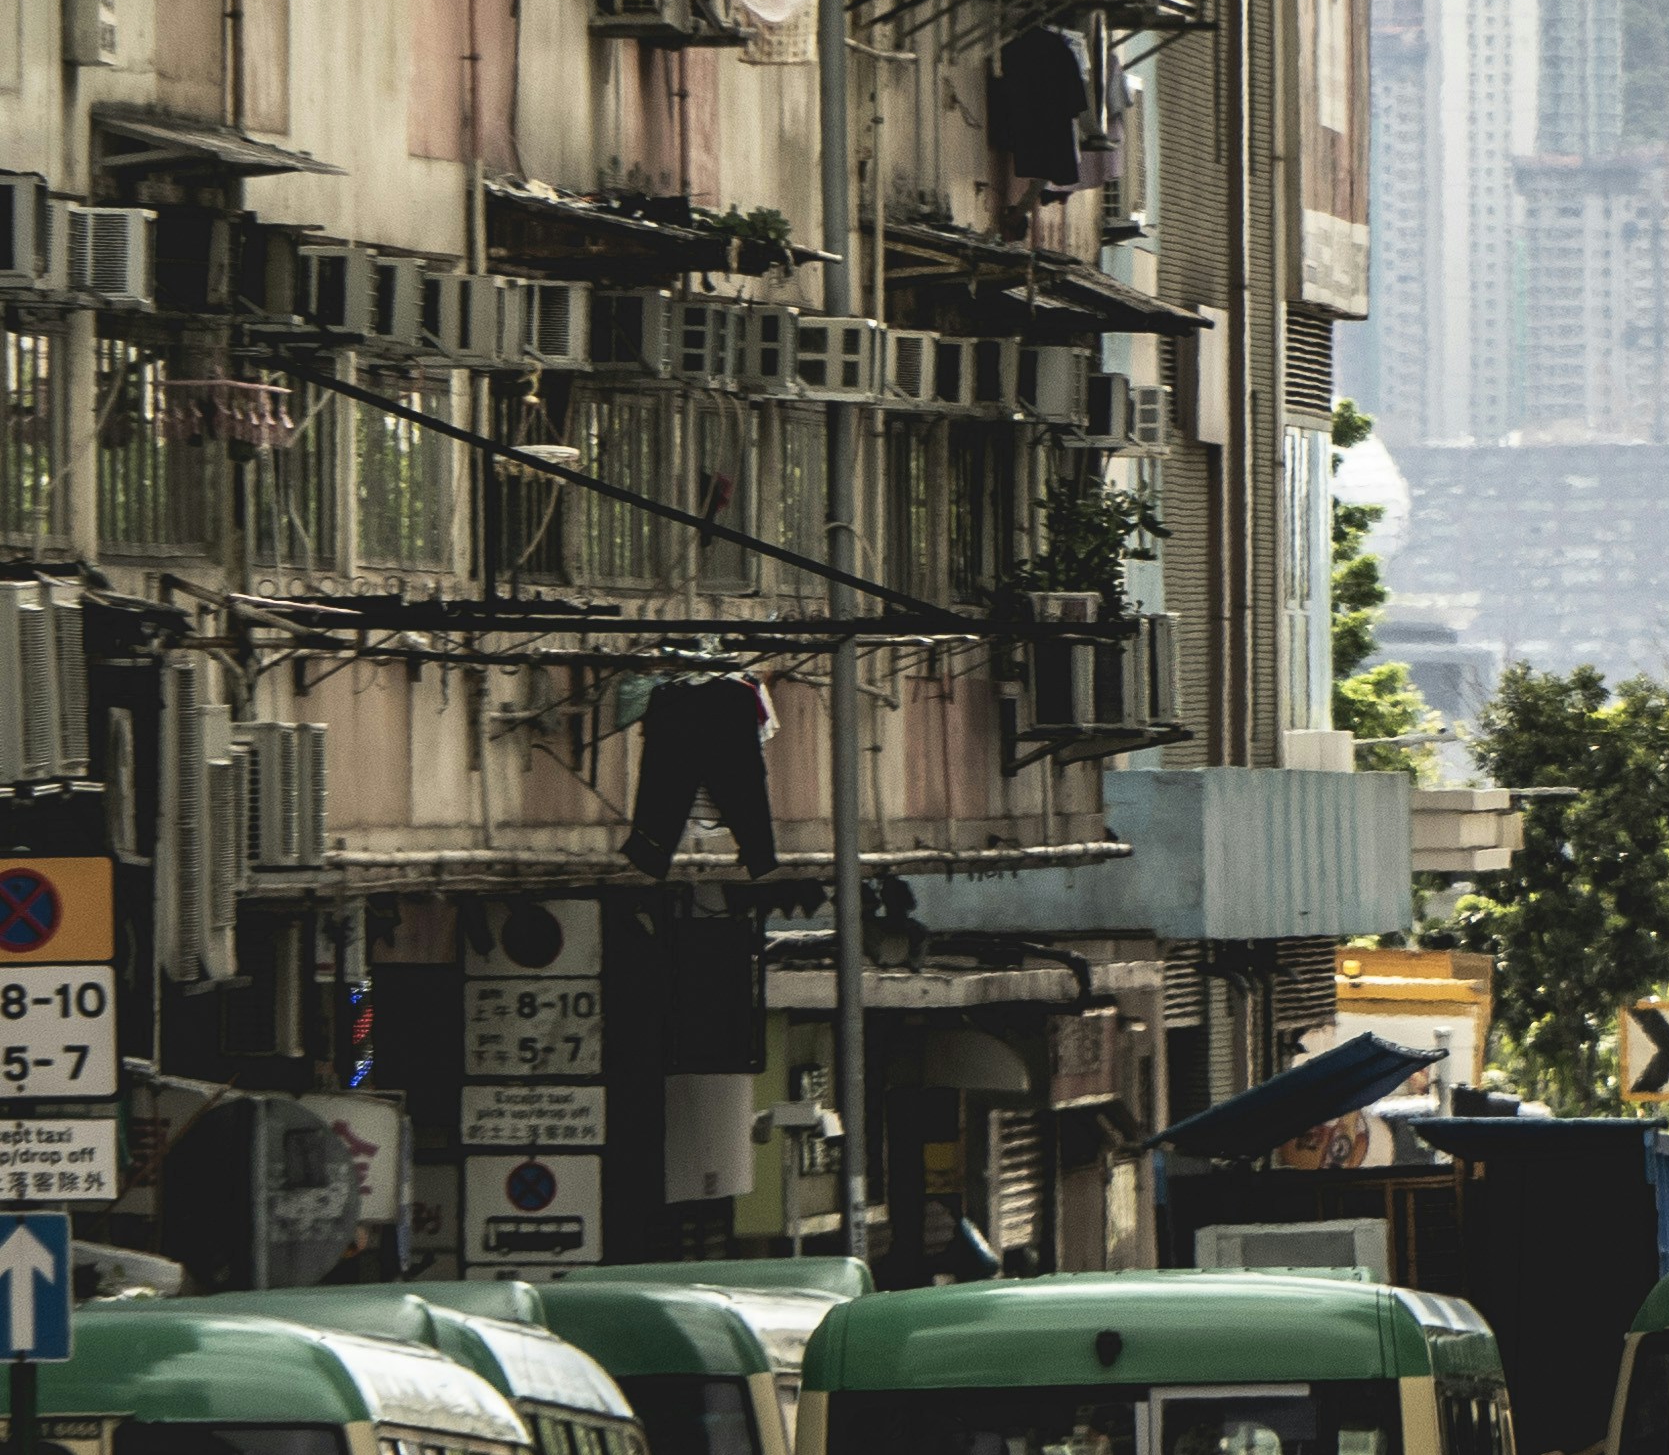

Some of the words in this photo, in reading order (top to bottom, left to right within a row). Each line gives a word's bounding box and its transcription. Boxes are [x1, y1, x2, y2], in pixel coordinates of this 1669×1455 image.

[1, 982, 106, 1020] 8-10
[517, 992, 595, 1019] 8-10
[36, 1127, 73, 1144] taxi
[67, 1147, 97, 1164] off
